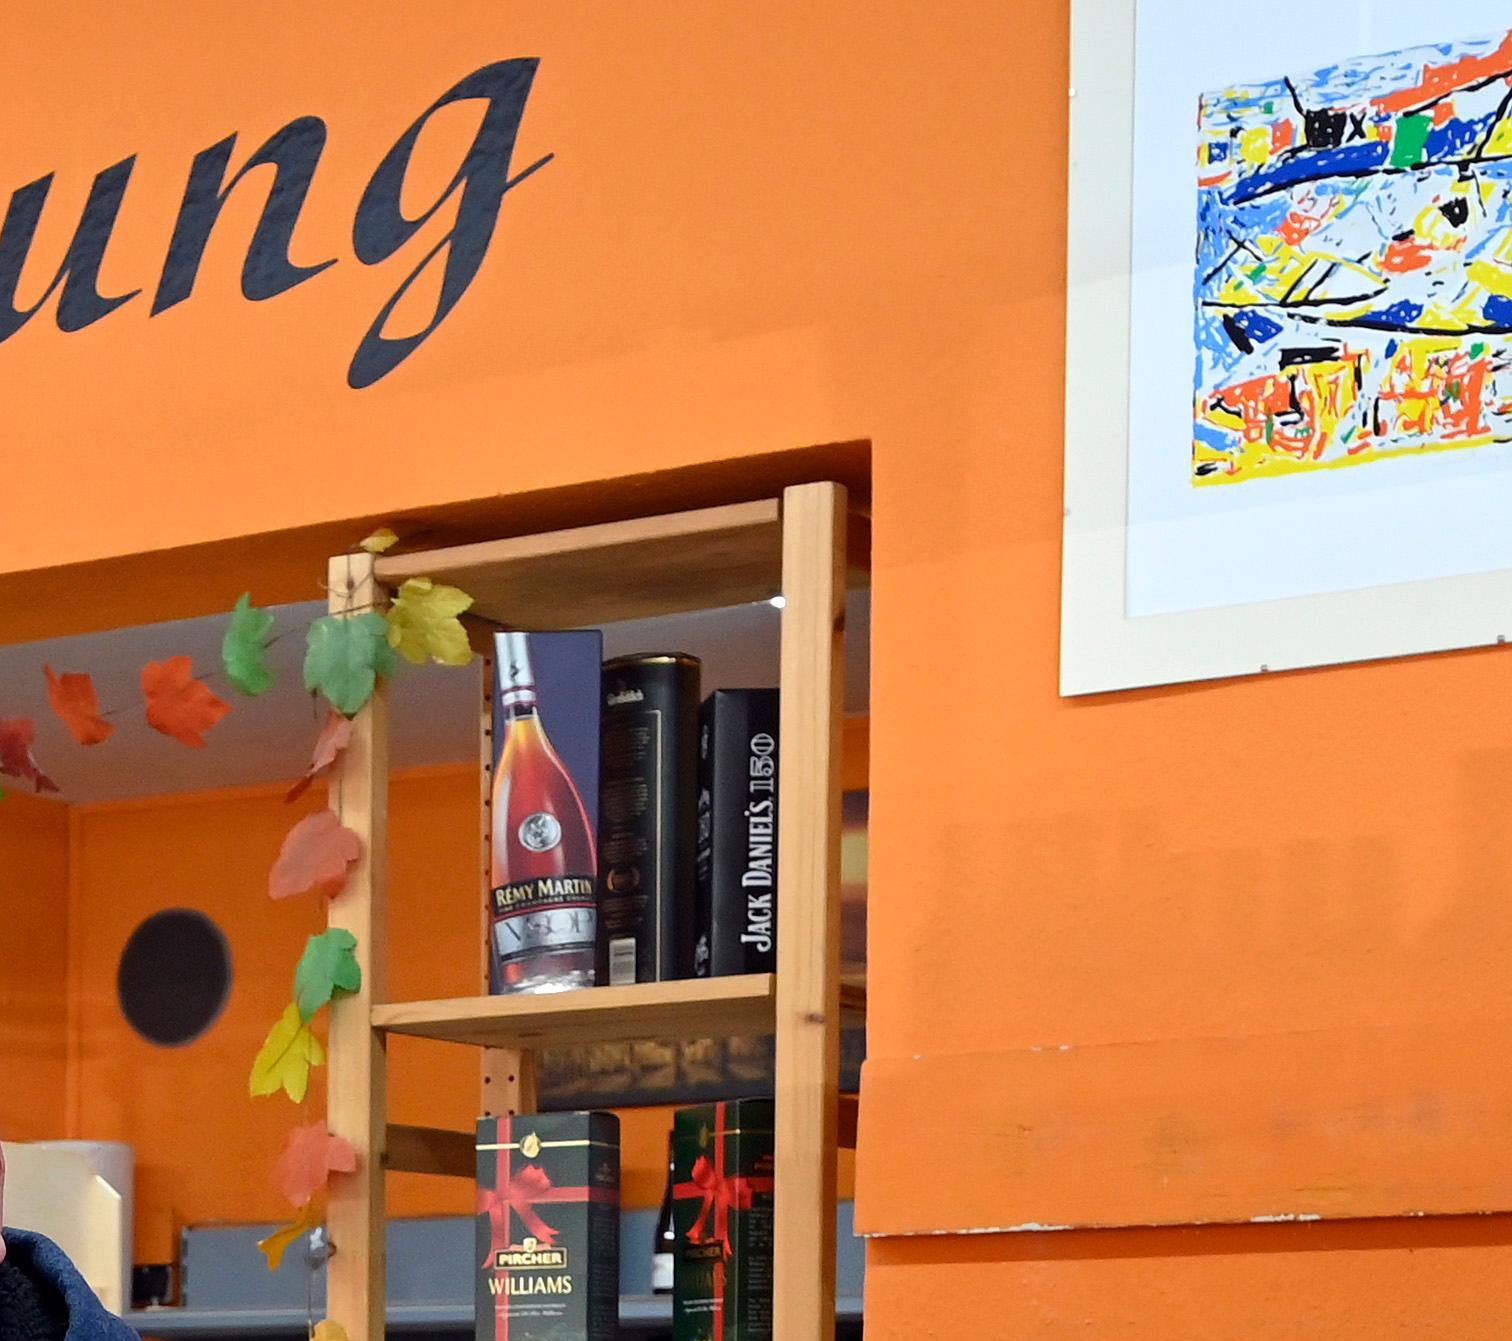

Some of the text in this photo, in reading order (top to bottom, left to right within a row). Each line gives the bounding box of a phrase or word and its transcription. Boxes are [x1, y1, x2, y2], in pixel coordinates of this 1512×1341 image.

[749, 732, 775, 794] 150
[538, 878, 593, 897] MARTIN
[741, 895, 772, 952] JACK
[499, 1251, 562, 1266] PIRCHER
[489, 1275, 572, 1295] WILLIAMS
